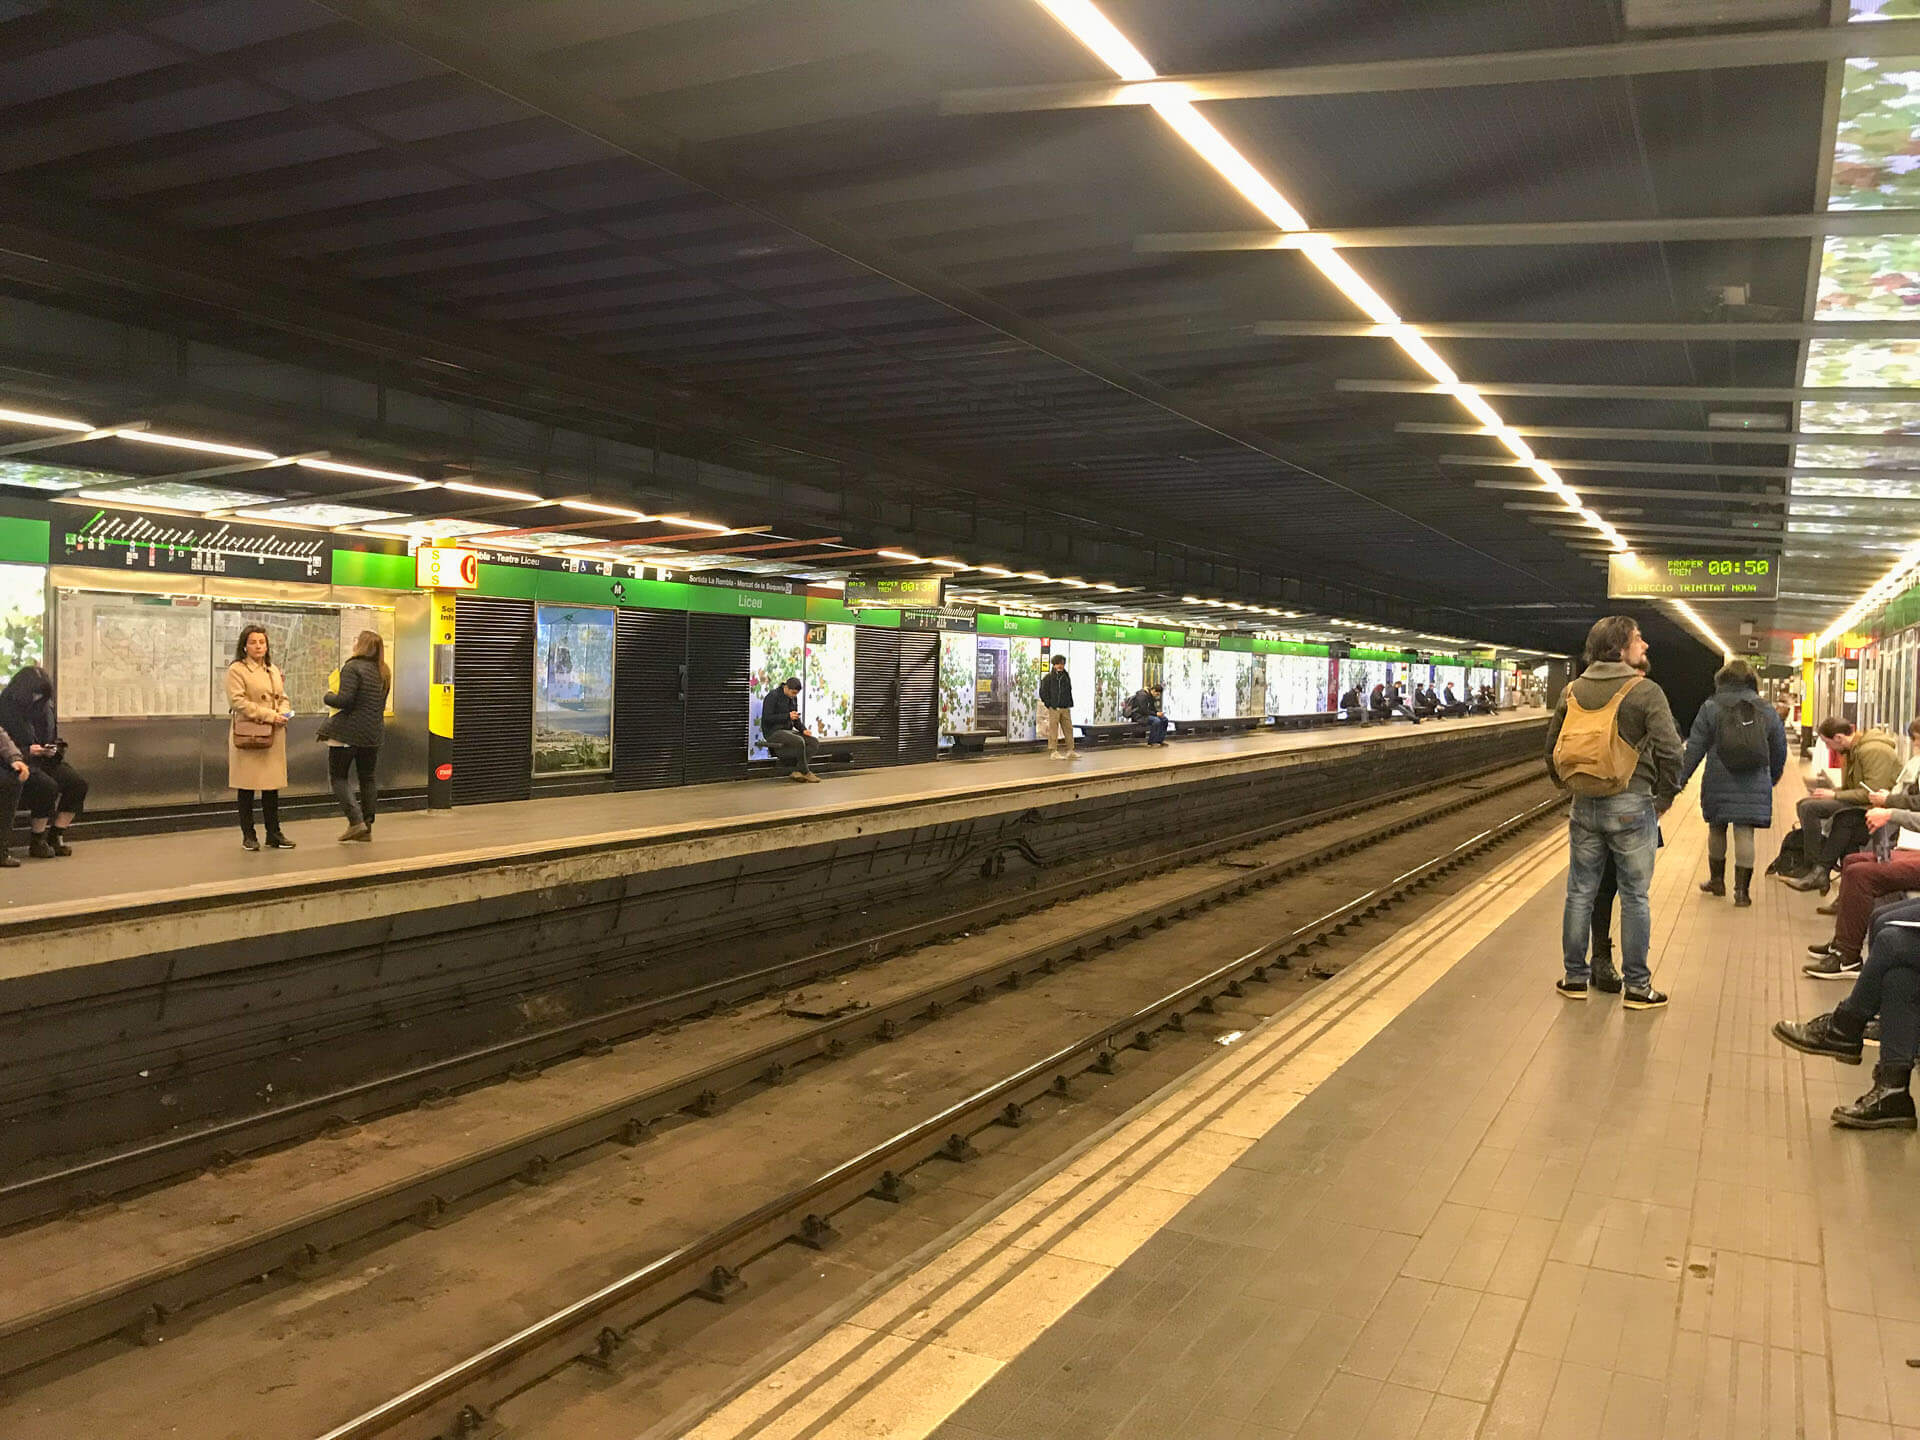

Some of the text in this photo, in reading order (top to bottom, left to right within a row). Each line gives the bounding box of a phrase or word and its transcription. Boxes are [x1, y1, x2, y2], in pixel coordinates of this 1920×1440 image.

[496, 552, 519, 564] Teatre
[520, 555, 540, 566] Liceu
[431, 549, 440, 586] SOS
[1667, 560, 1769, 576] PROPER 00:50
[1668, 568, 1692, 576] TREN
[688, 574, 708, 583] Sortida
[1680, 583, 1726, 593] TRINITAT
[1731, 583, 1757, 593] NOVA
[738, 594, 763, 609] Liceu
